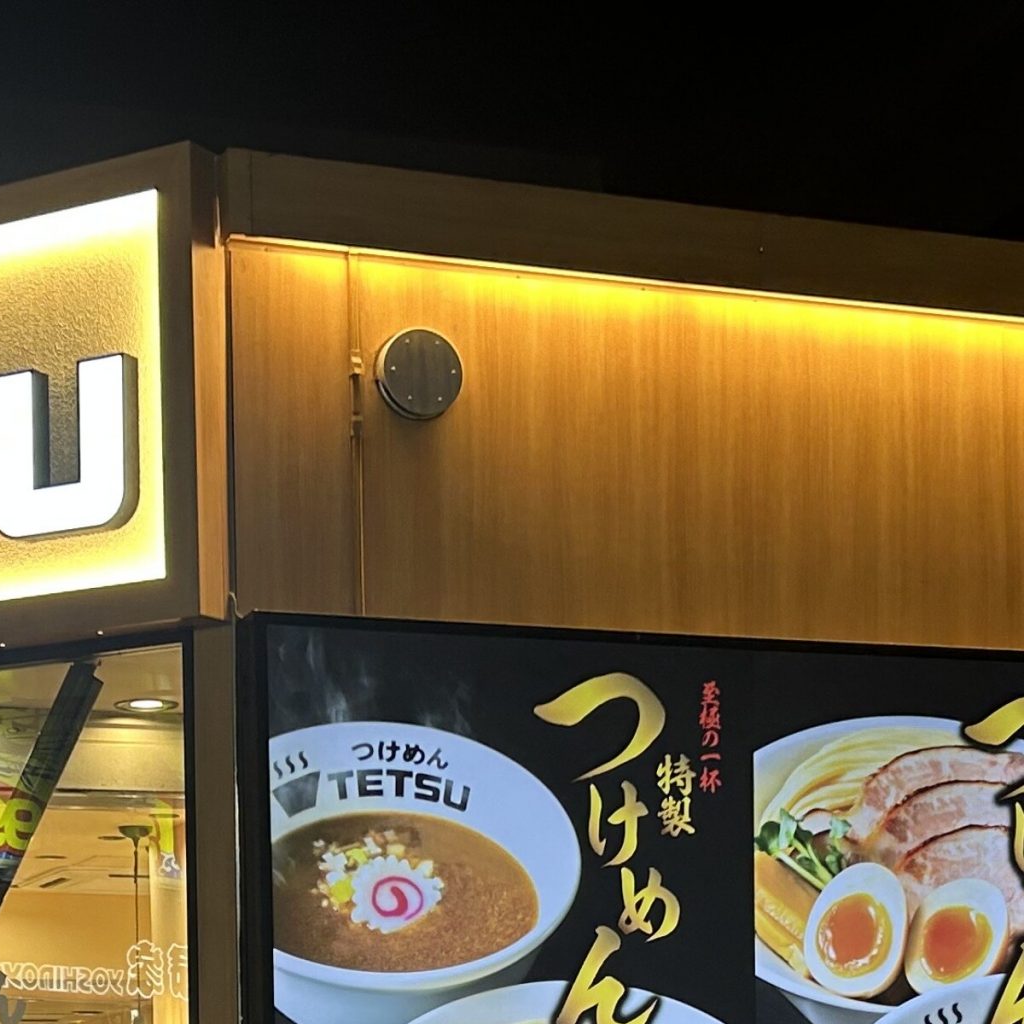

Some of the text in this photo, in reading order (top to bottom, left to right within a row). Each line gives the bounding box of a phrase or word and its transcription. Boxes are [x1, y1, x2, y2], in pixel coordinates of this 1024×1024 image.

[351, 740, 449, 770] つけめん
[699, 680, 722, 794] 至極の一杯
[327, 769, 471, 812] TETSU
[656, 753, 696, 837] 特製
